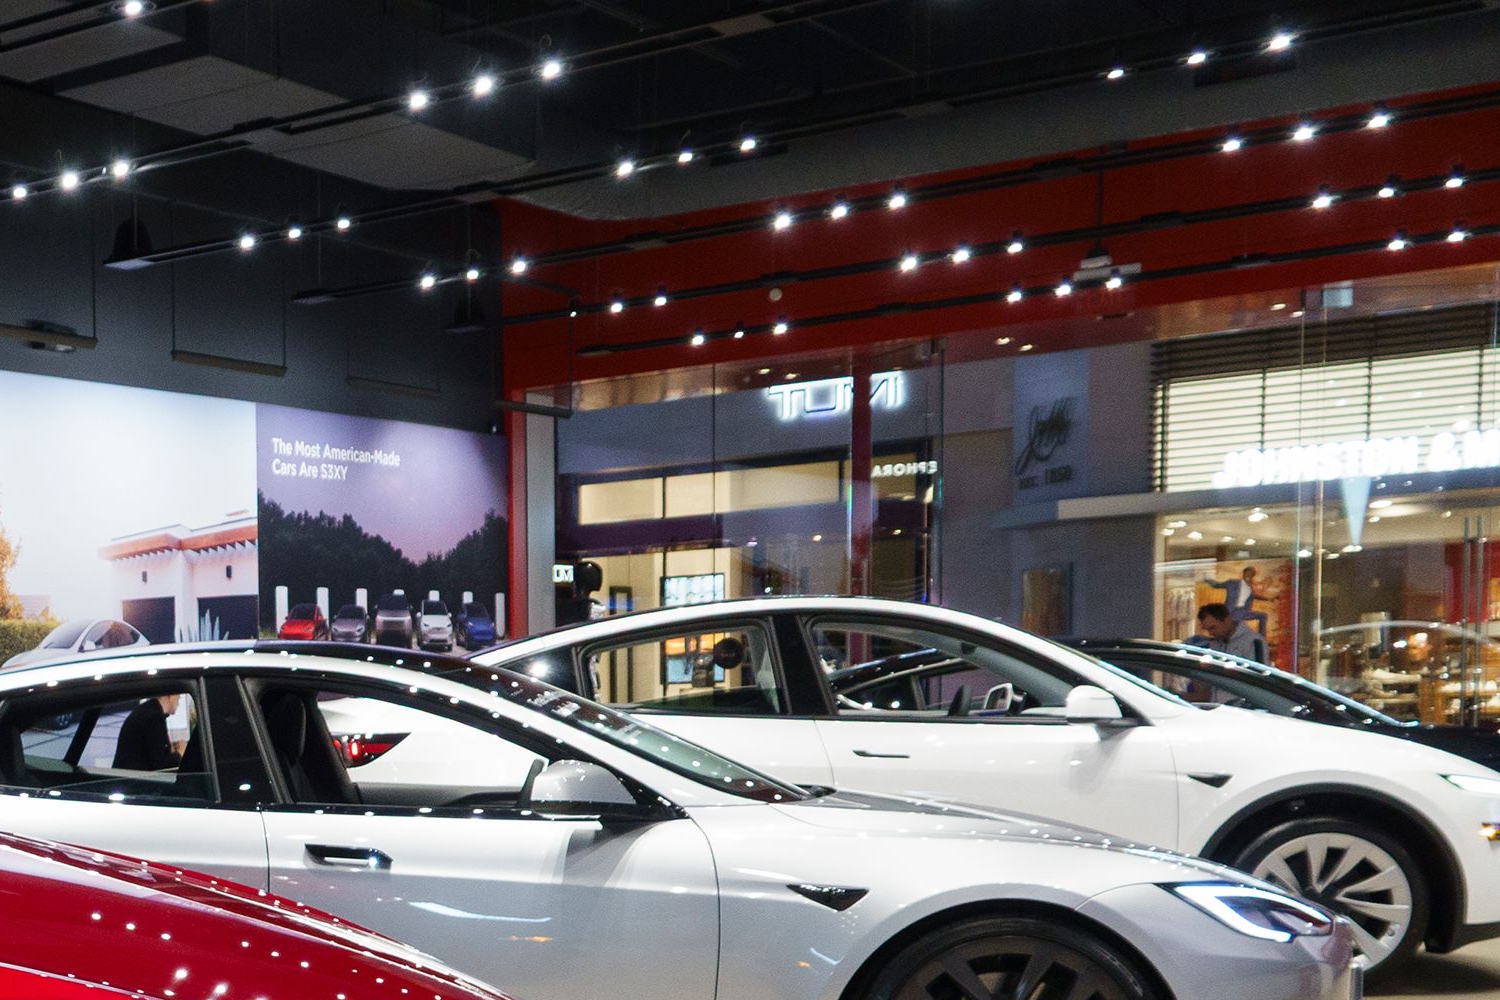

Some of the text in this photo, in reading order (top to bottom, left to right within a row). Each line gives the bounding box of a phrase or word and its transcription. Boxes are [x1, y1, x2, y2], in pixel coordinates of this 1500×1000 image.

[767, 369, 903, 420] TUMI
[272, 437, 401, 467] The Most American-Made
[272, 458, 348, 480] Cars Are S3XY
[1212, 436, 1418, 489] JOHNSTON
[1428, 432, 1461, 471] &
